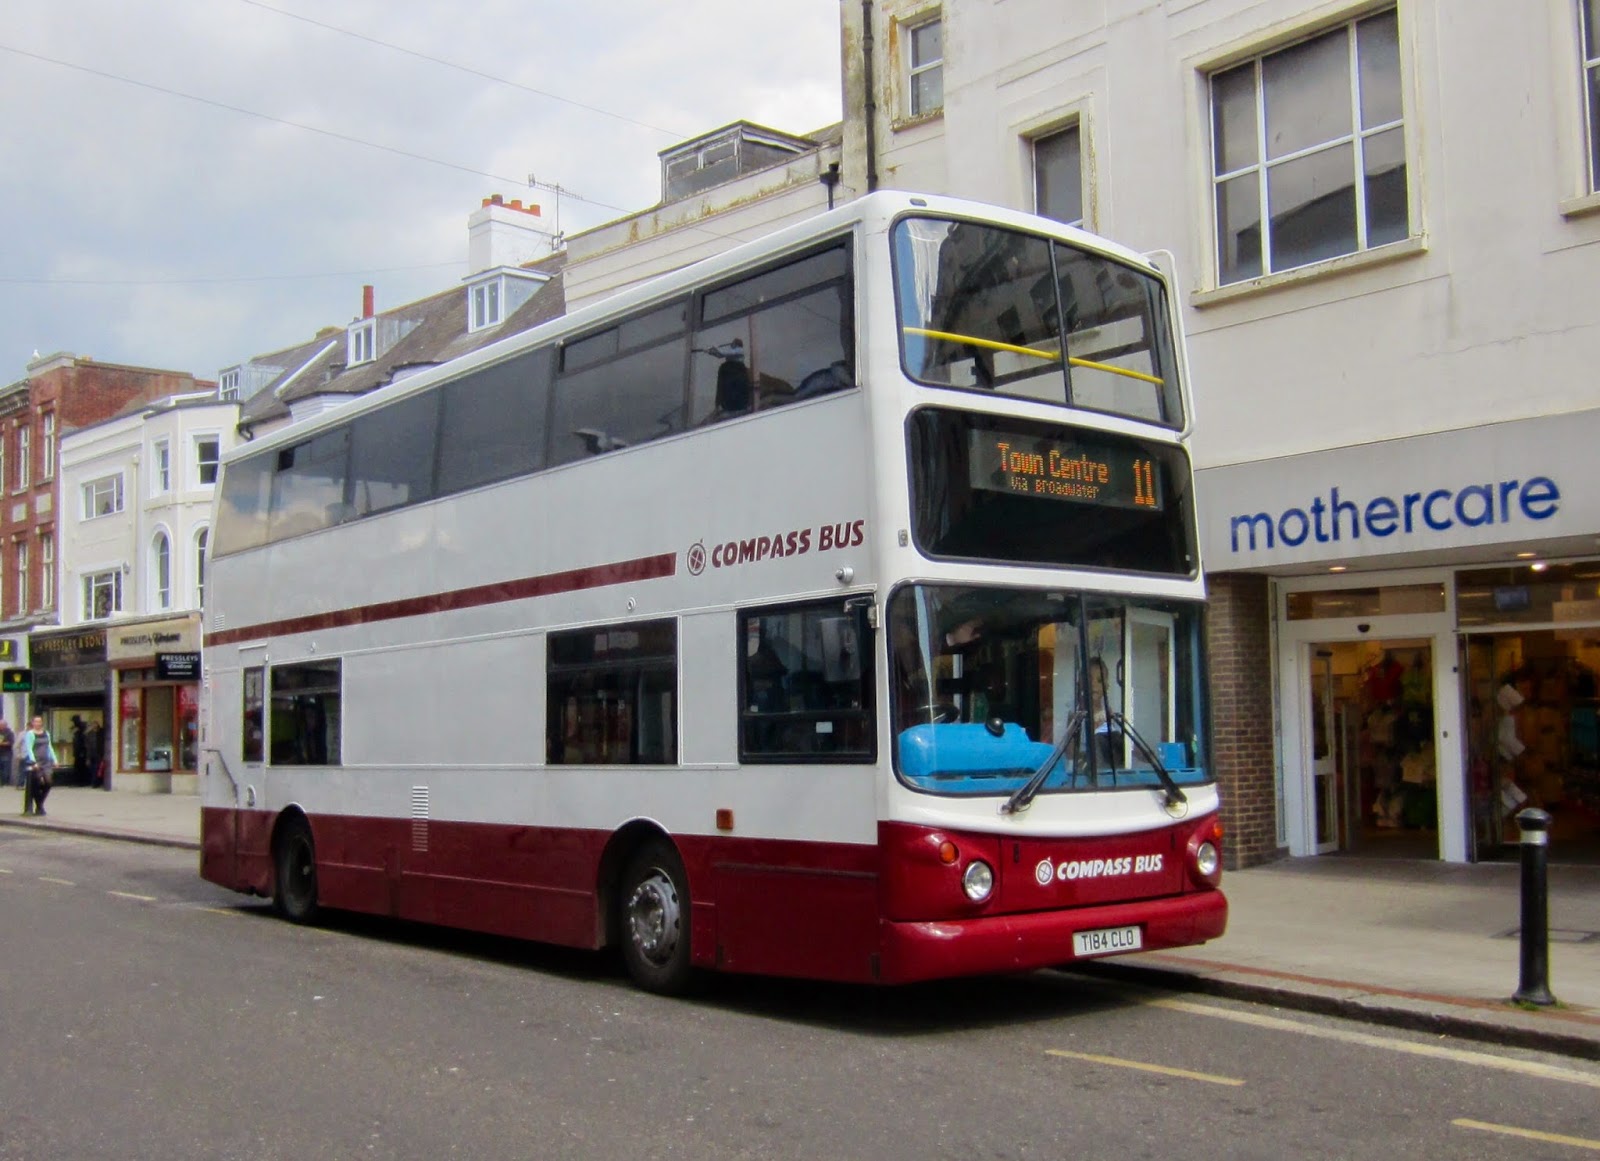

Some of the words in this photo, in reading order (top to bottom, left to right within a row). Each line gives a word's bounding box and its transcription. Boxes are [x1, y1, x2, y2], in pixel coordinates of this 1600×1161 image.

[997, 442, 1044, 476] Town
[1049, 449, 1110, 484] Centre
[1035, 479, 1100, 499] Broadwater
[1132, 458, 1156, 505] 11
[1230, 475, 1561, 552] mothercare
[712, 528, 812, 568] COMPASS
[818, 519, 865, 551] BUS
[161, 654, 199, 662] PRESSLEYS
[1057, 857, 1131, 880] COMPASS
[1134, 854, 1163, 874] BUS
[1081, 932, 1108, 952] T184
[1111, 929, 1134, 948] CLO
